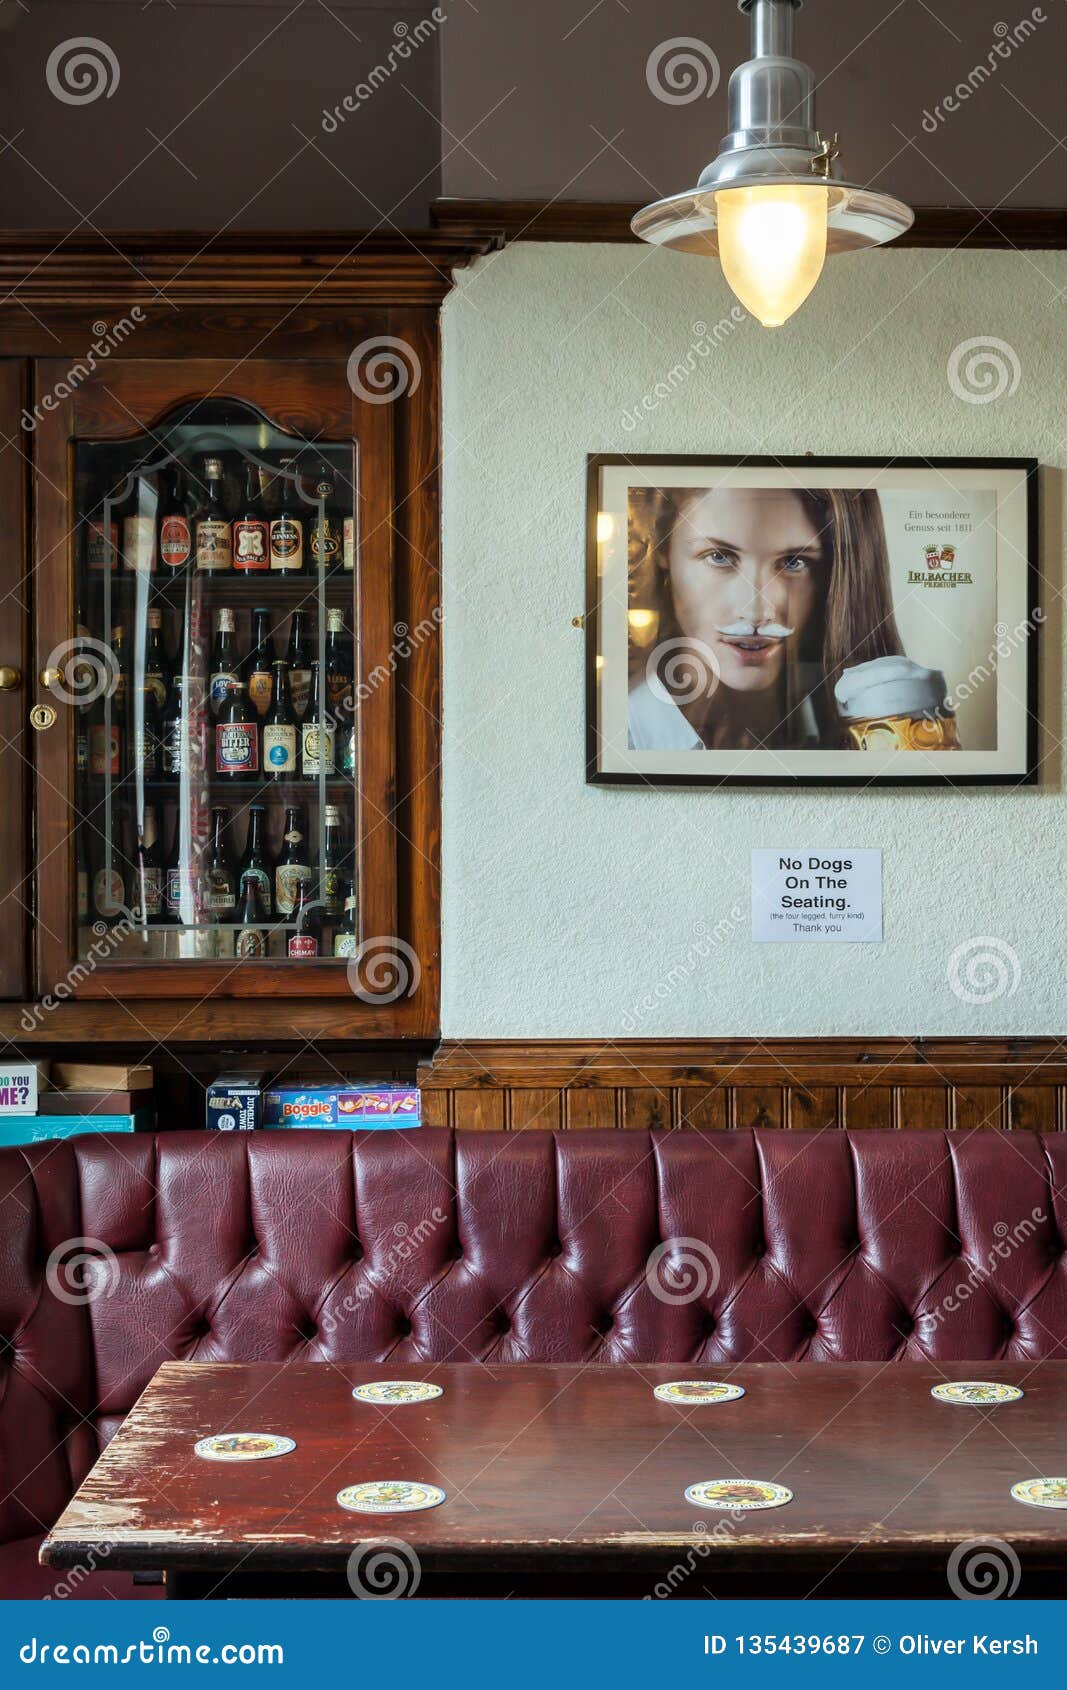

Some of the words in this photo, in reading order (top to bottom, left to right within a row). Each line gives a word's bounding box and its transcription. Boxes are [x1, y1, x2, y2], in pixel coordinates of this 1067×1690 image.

[908, 510, 923, 520] Ein
[925, 510, 971, 520] besonderer
[904, 523, 935, 532] Genuss
[936, 523, 951, 532] seit
[955, 523, 973, 532] 1811
[907, 570, 973, 583] IRLBACHER
[221, 737, 250, 747] BITTER
[779, 857, 802, 870] No
[808, 857, 853, 873] Dogs
[785, 876, 809, 889] On
[815, 876, 848, 889] The
[781, 895, 851, 911] Seating.
[770, 912, 784, 921] (the
[785, 912, 799, 920] four
[829, 912, 845, 921] furry
[847, 912, 865, 921] kind)
[793, 923, 822, 933] Thank
[825, 925, 842, 934] you
[12, 1076, 30, 1087] YOU
[283, 1102, 331, 1117] Boggle
